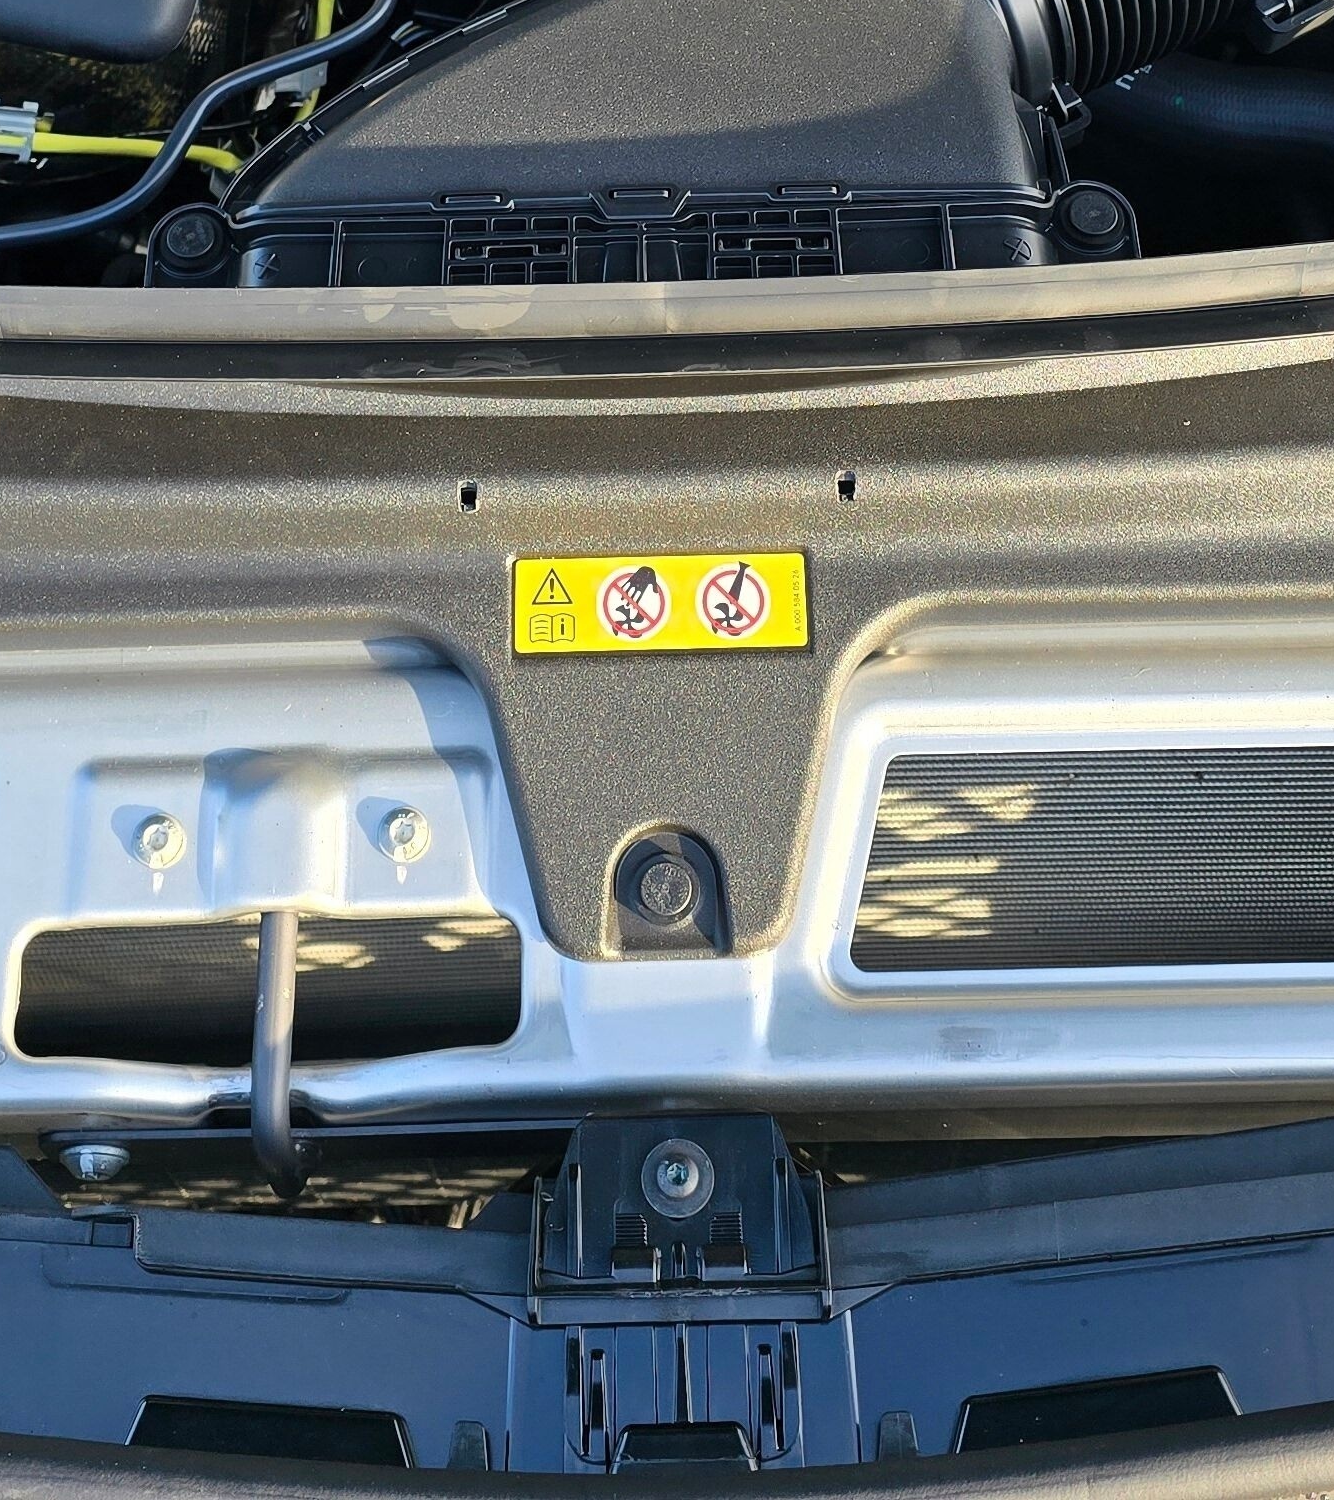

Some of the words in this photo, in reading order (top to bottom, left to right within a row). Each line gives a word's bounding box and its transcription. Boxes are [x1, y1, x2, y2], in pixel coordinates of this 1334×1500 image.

[792, 569, 800, 579] 26
[793, 593, 801, 607] 584
[793, 609, 802, 624] 000
